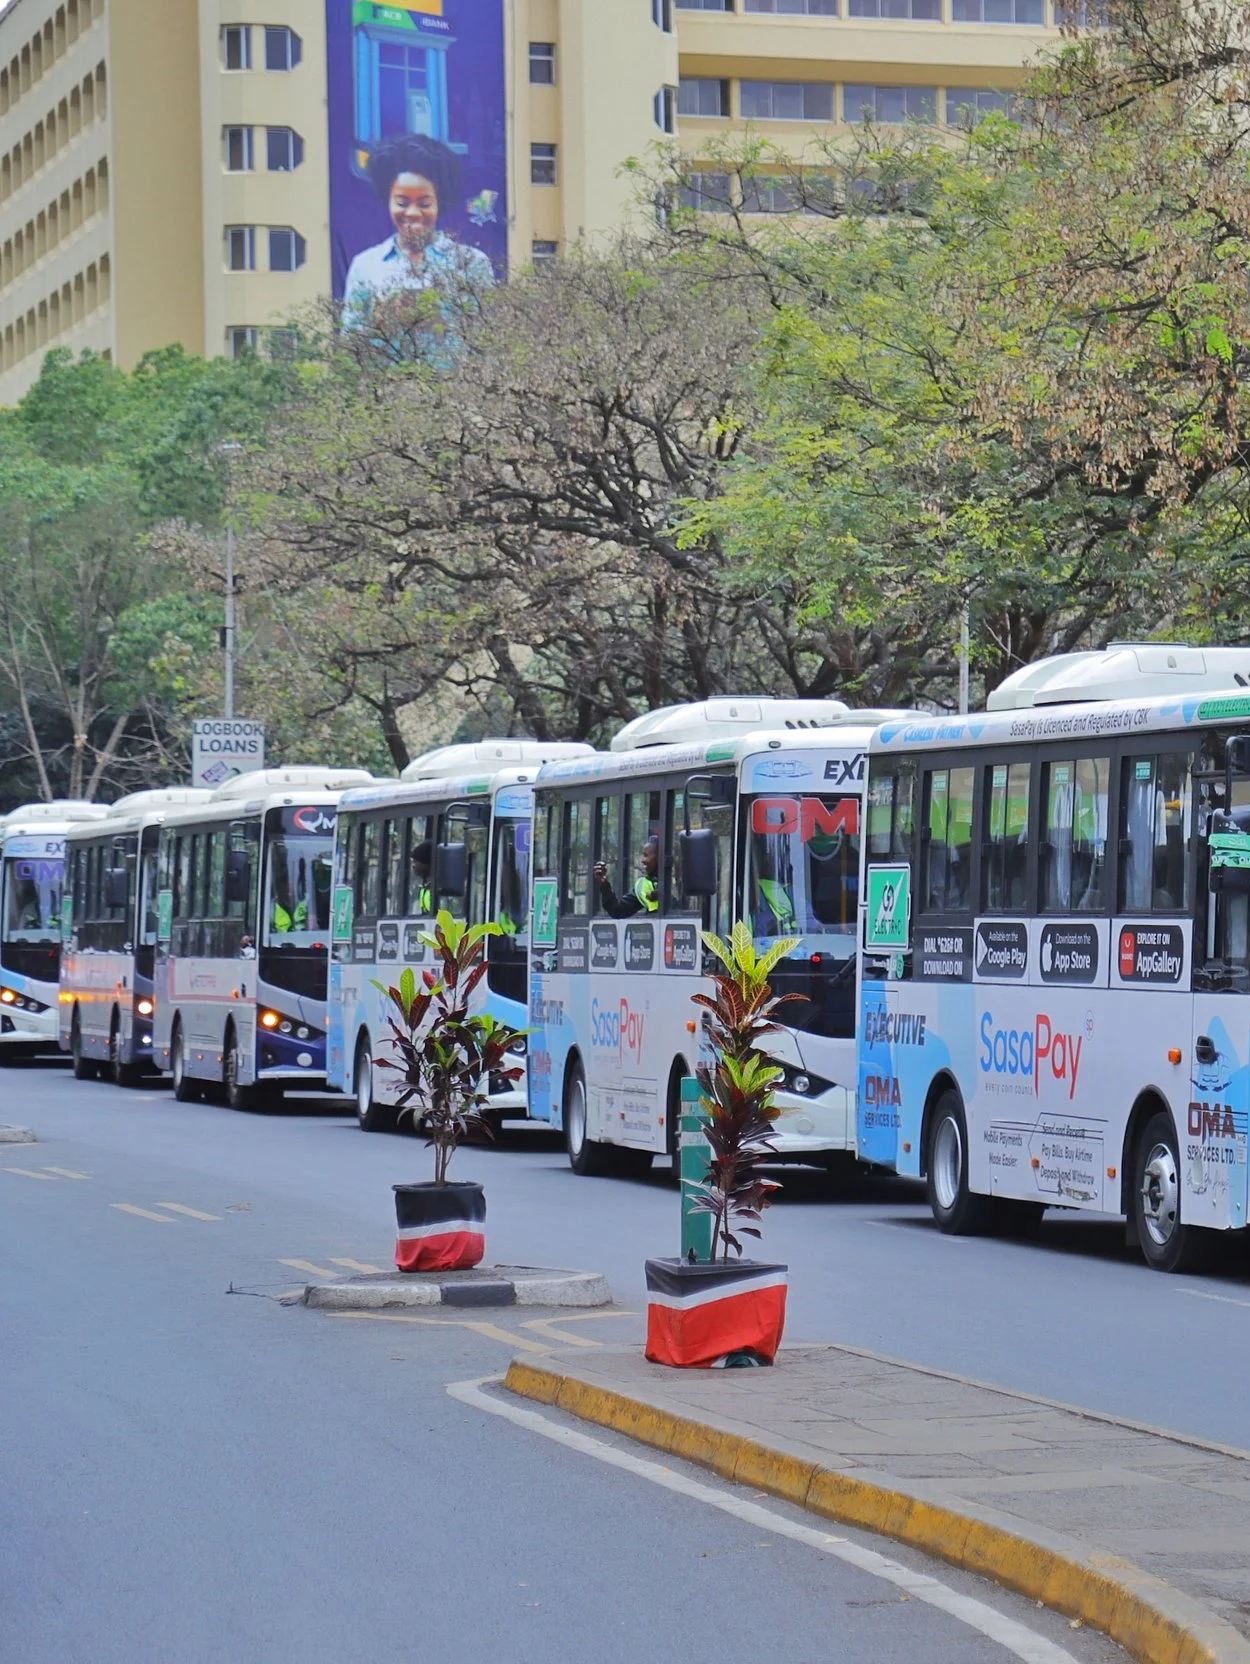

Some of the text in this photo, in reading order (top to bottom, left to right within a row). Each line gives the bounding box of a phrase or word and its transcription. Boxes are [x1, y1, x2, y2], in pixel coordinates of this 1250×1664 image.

[193, 722, 265, 736] LOGBOOK
[1009, 721, 1035, 739] SasaPay
[1073, 715, 1086, 731] and
[1087, 711, 1123, 734] Regulated
[1124, 711, 1133, 732] by
[1134, 708, 1151, 726] CBK
[200, 739, 258, 753] LOANS
[988, 947, 1026, 969] Google Play
[1054, 951, 1091, 973] App Store
[1136, 951, 1181, 979] AppGallery
[591, 997, 644, 1065] SasaPay
[865, 1003, 927, 1050] EXECUTIVE
[980, 1011, 1083, 1100] SasaPay
[865, 1075, 902, 1111] OMA
[1188, 1102, 1236, 1145] OMA
